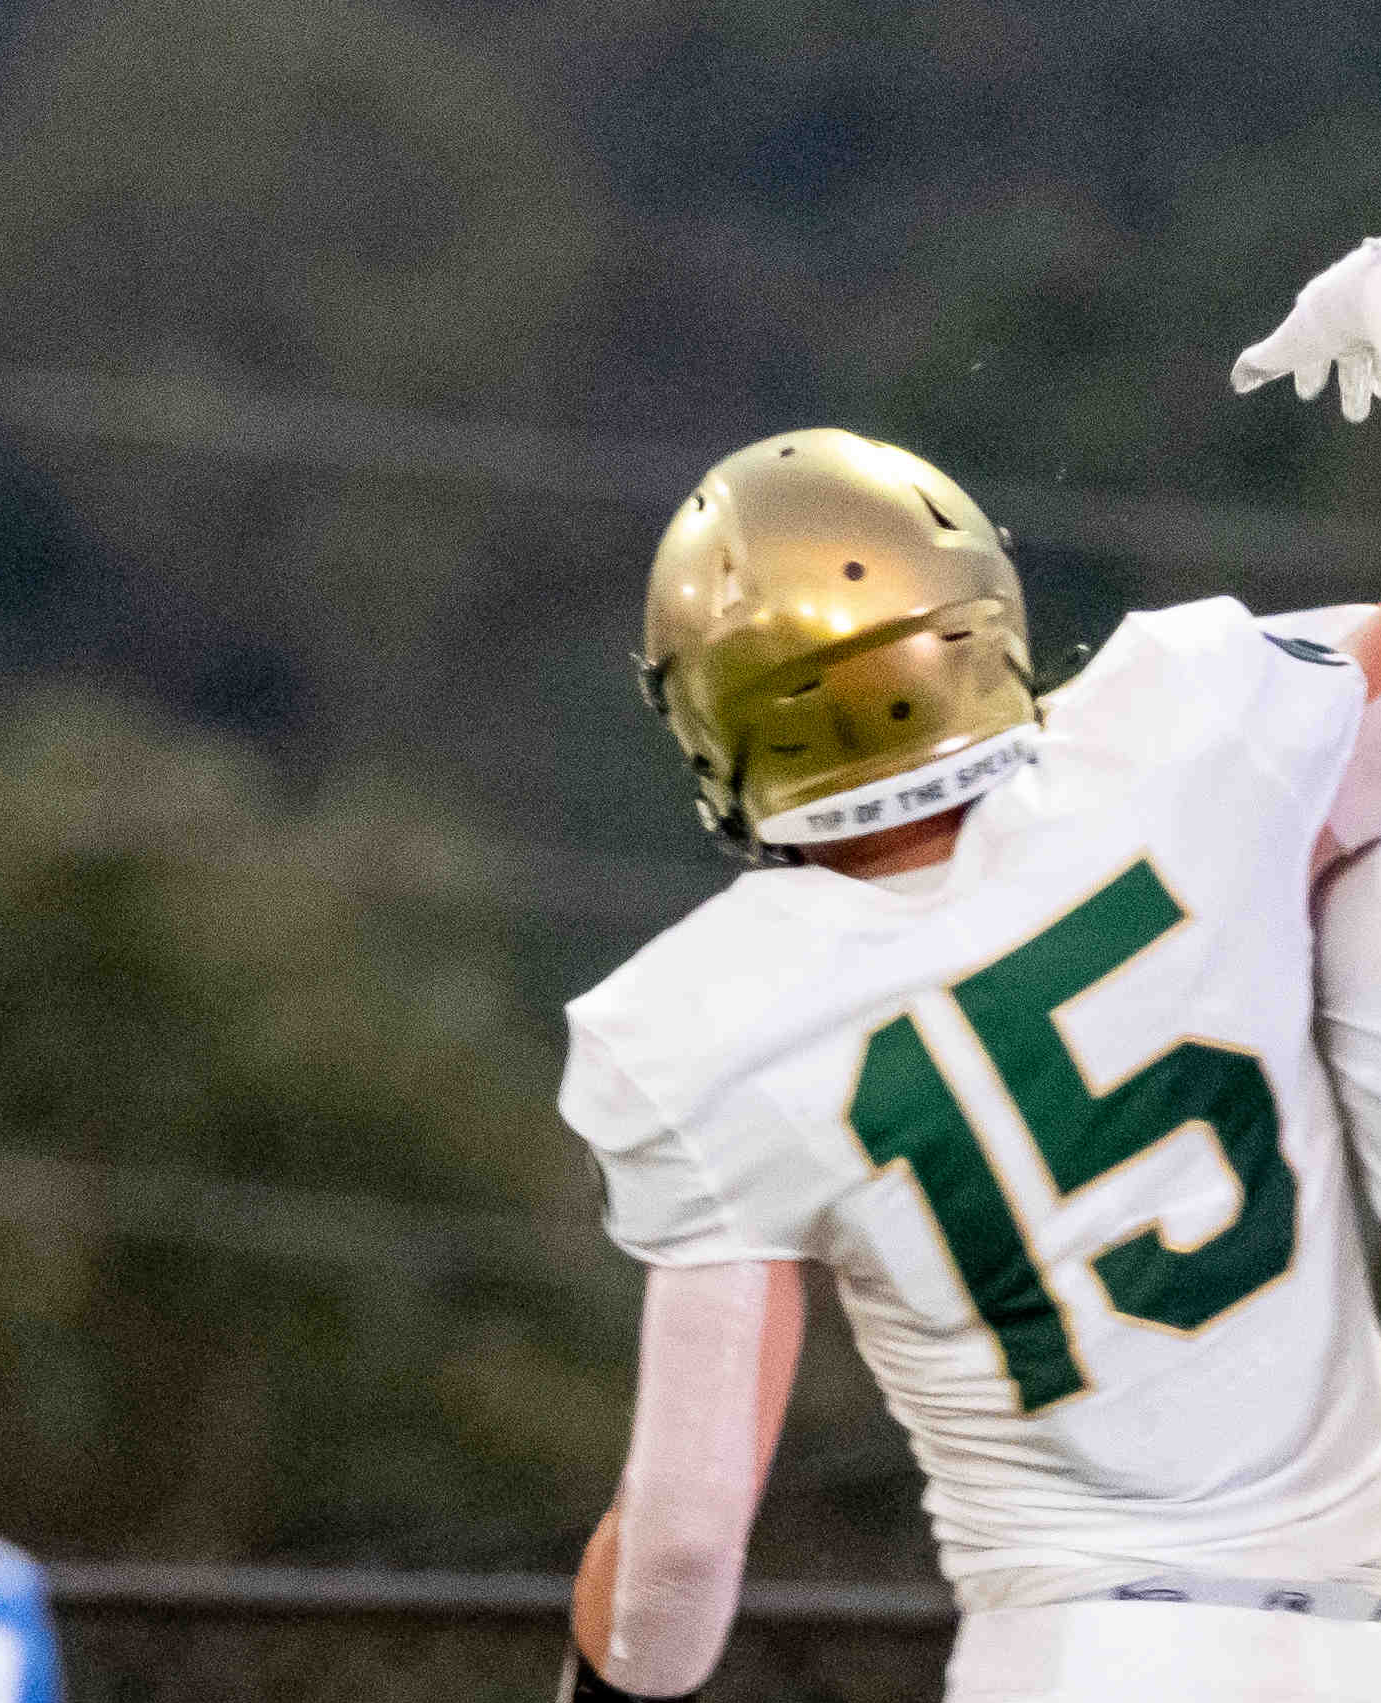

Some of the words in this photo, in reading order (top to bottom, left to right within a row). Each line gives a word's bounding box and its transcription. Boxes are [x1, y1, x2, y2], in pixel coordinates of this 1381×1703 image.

[806, 808, 845, 834] TIP
[854, 798, 885, 825] OF
[896, 776, 946, 811] THE
[841, 854, 1301, 1416] 15
